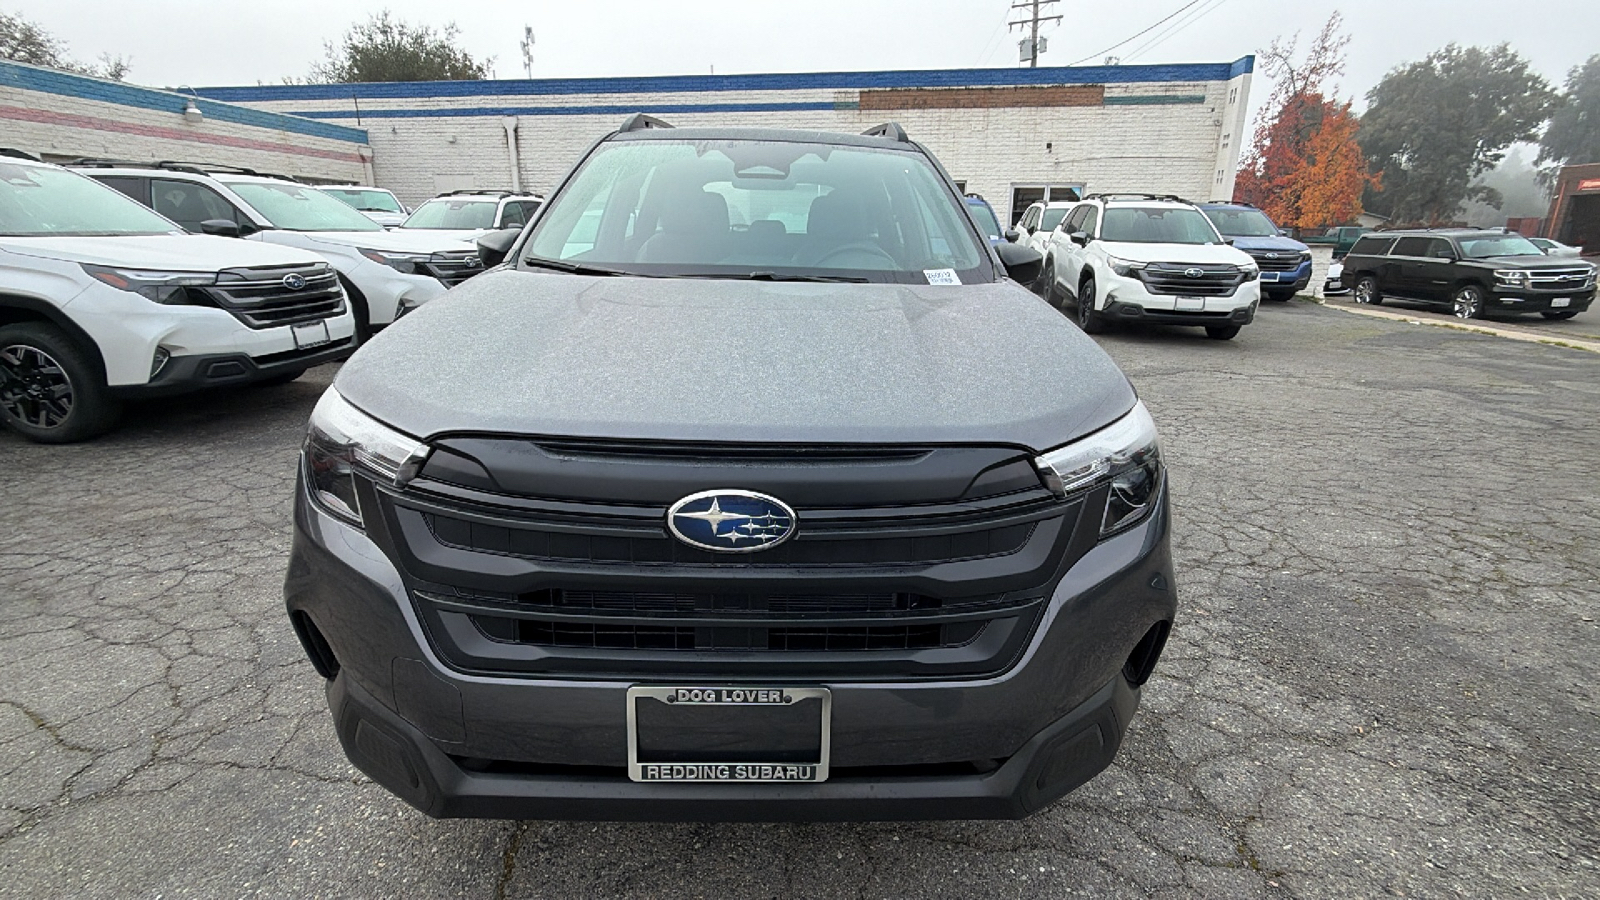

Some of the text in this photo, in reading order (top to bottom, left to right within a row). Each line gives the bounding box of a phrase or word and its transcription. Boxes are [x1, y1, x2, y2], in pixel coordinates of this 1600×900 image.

[677, 689, 781, 703] DOG LOVER
[647, 765, 811, 779] REDDING SUBARU
